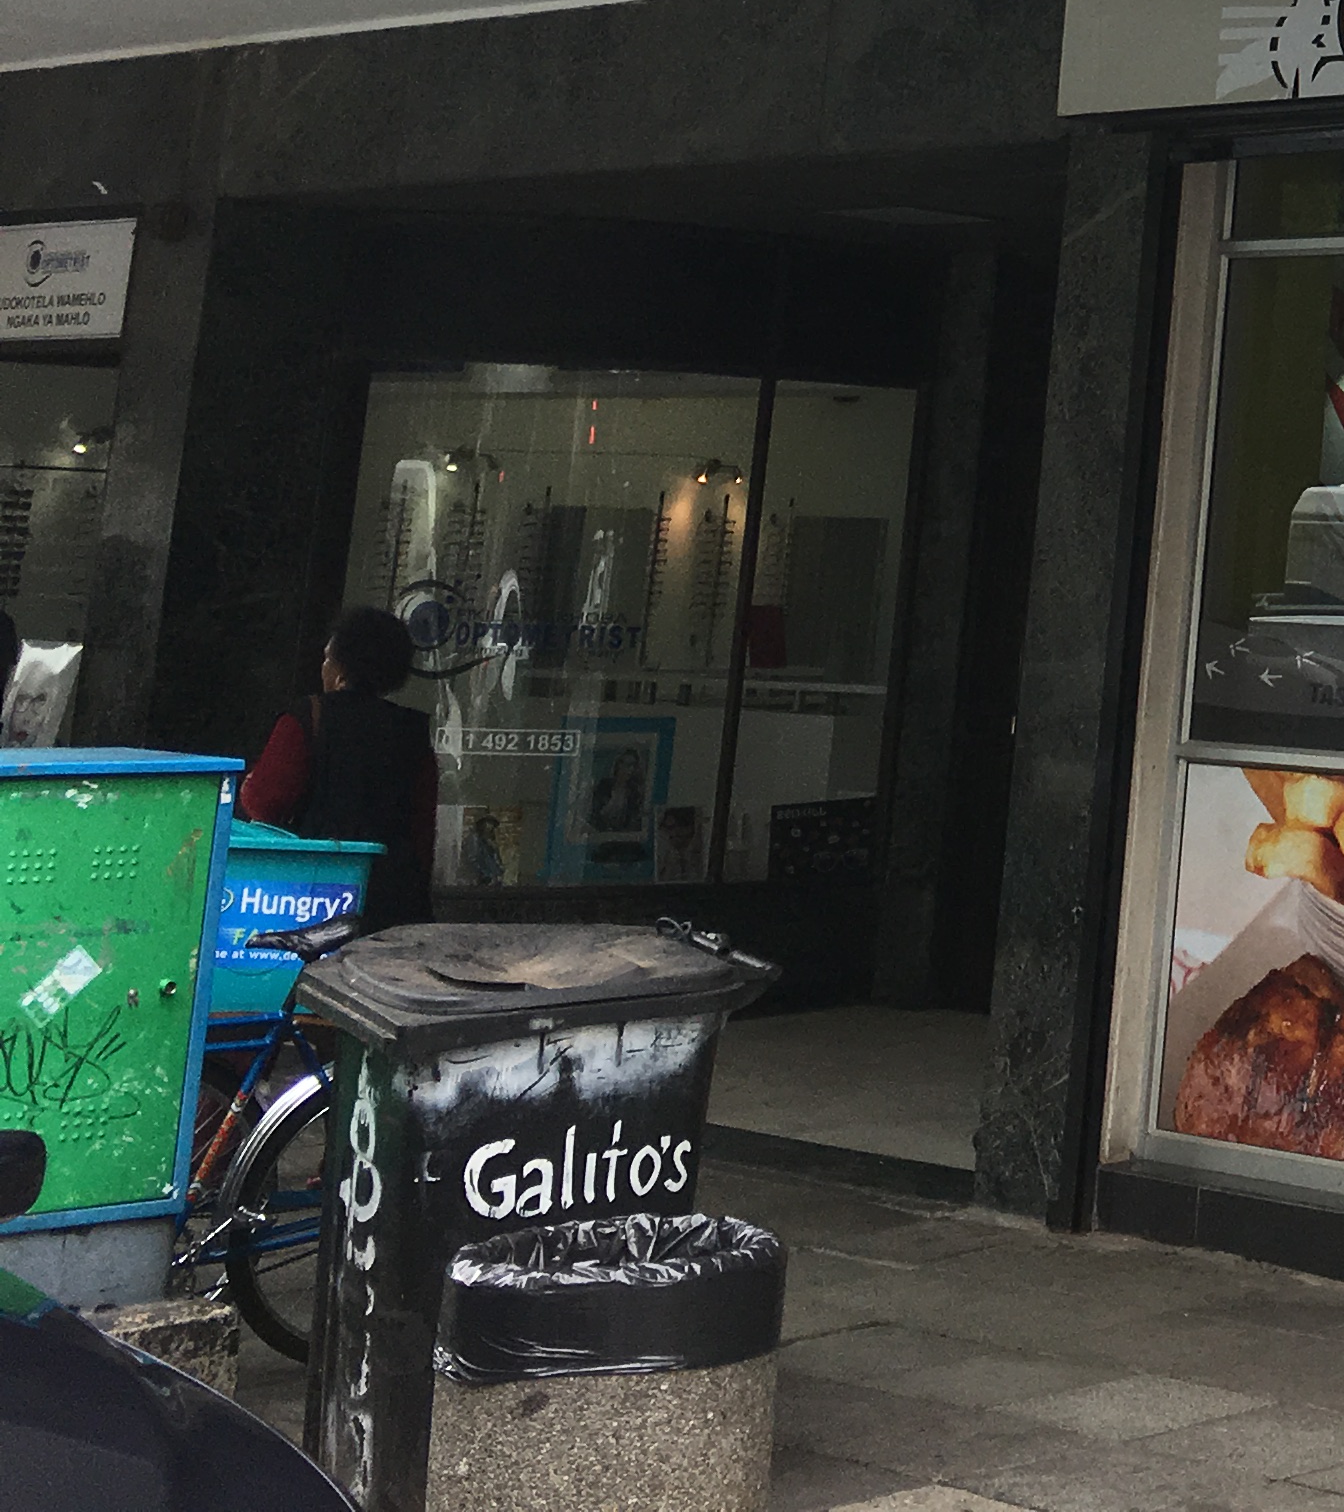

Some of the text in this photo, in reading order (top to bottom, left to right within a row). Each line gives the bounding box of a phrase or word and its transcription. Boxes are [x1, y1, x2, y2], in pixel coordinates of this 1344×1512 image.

[481, 733, 519, 751] 492
[526, 733, 574, 751] 1853
[240, 887, 354, 923] Hungry?
